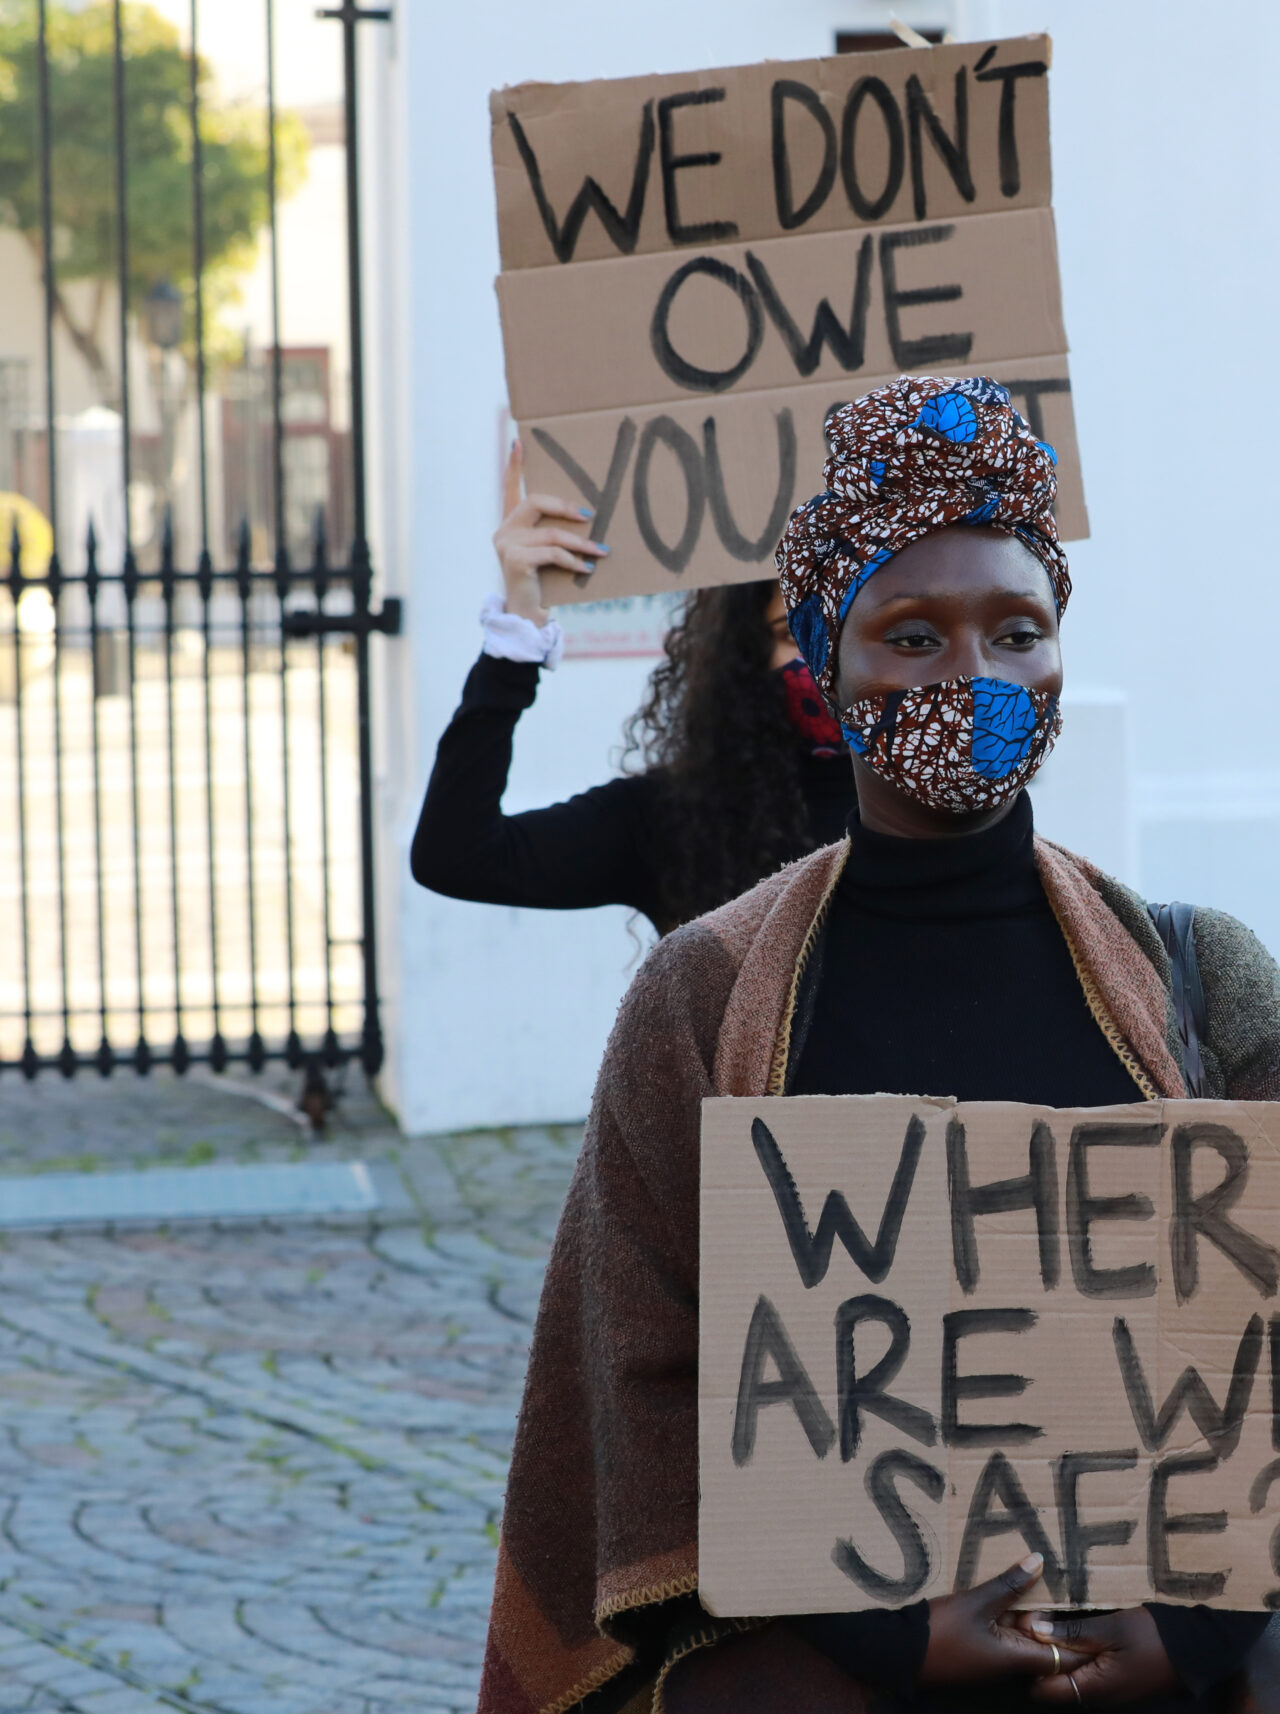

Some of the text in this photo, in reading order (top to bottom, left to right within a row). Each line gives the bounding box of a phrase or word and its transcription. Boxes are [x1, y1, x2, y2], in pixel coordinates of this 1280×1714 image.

[507, 46, 1049, 264] WE DON'T
[650, 224, 974, 393] OWE
[531, 406, 797, 589] YOU
[732, 1294, 1048, 1468] ARE
